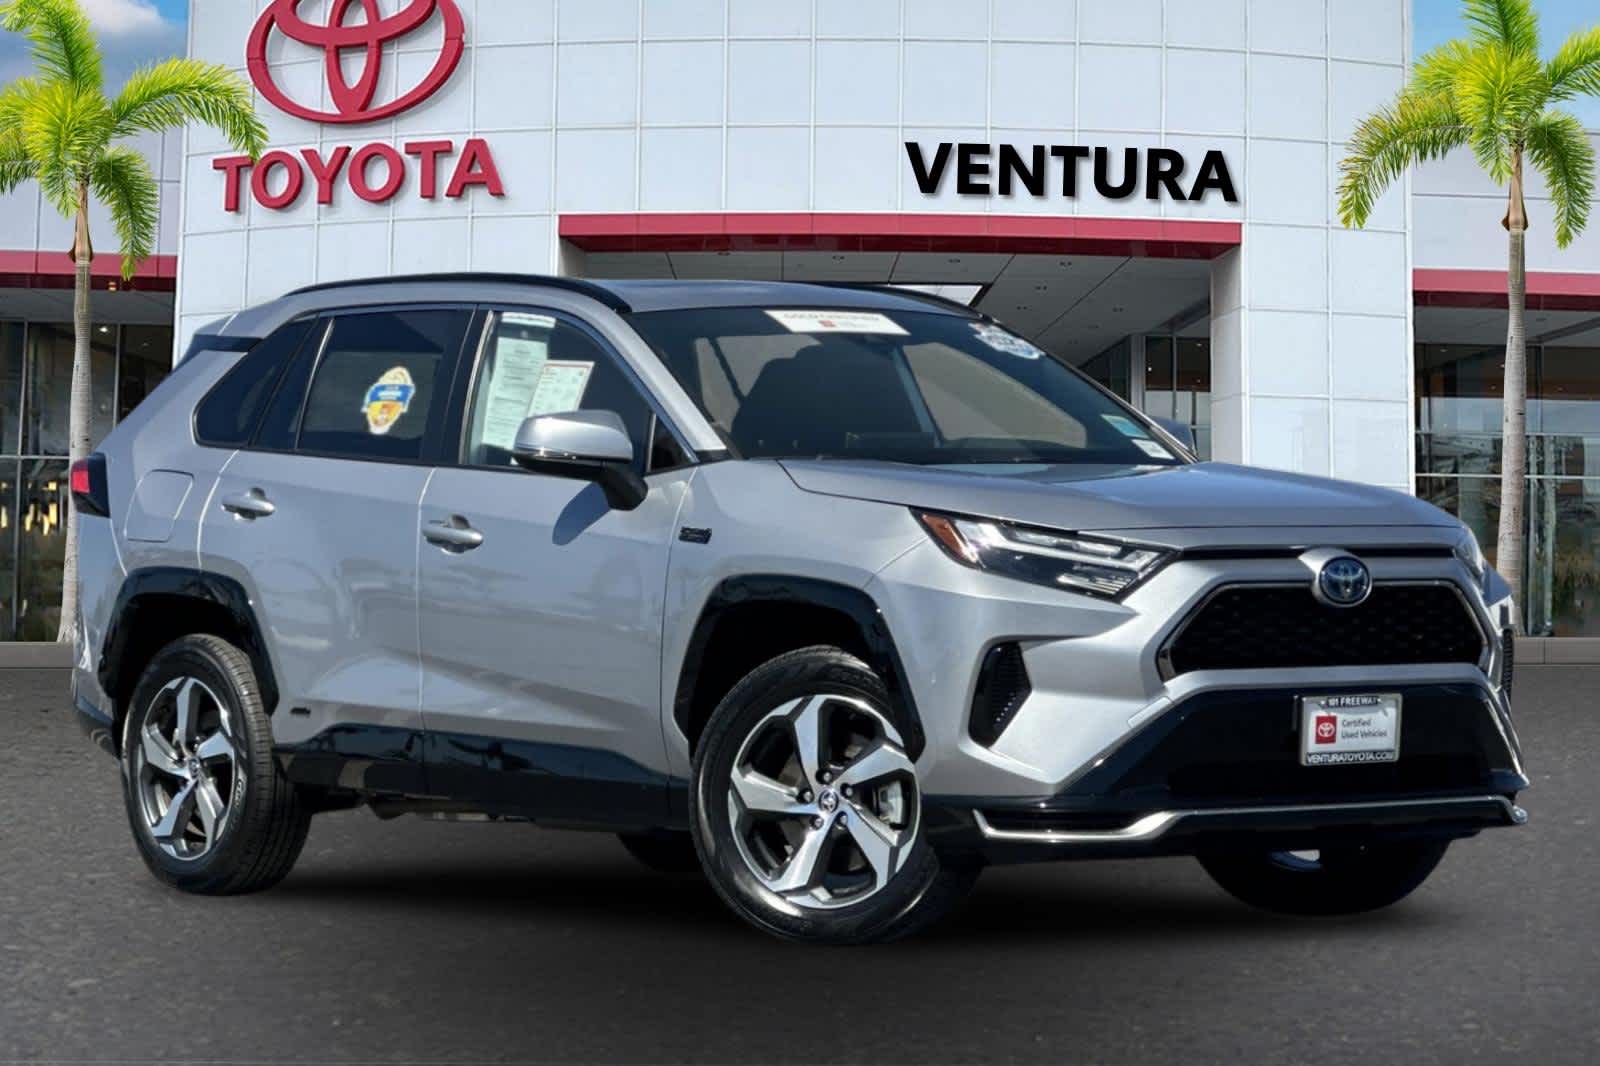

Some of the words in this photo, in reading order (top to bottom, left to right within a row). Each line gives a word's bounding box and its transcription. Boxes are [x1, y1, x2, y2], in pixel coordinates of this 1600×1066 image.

[212, 138, 505, 212] TOYOTA
[904, 142, 1239, 203] VENTURA
[1341, 718, 1371, 728] Certified
[1341, 730, 1359, 738] Used
[1360, 729, 1387, 738] Vehicles
